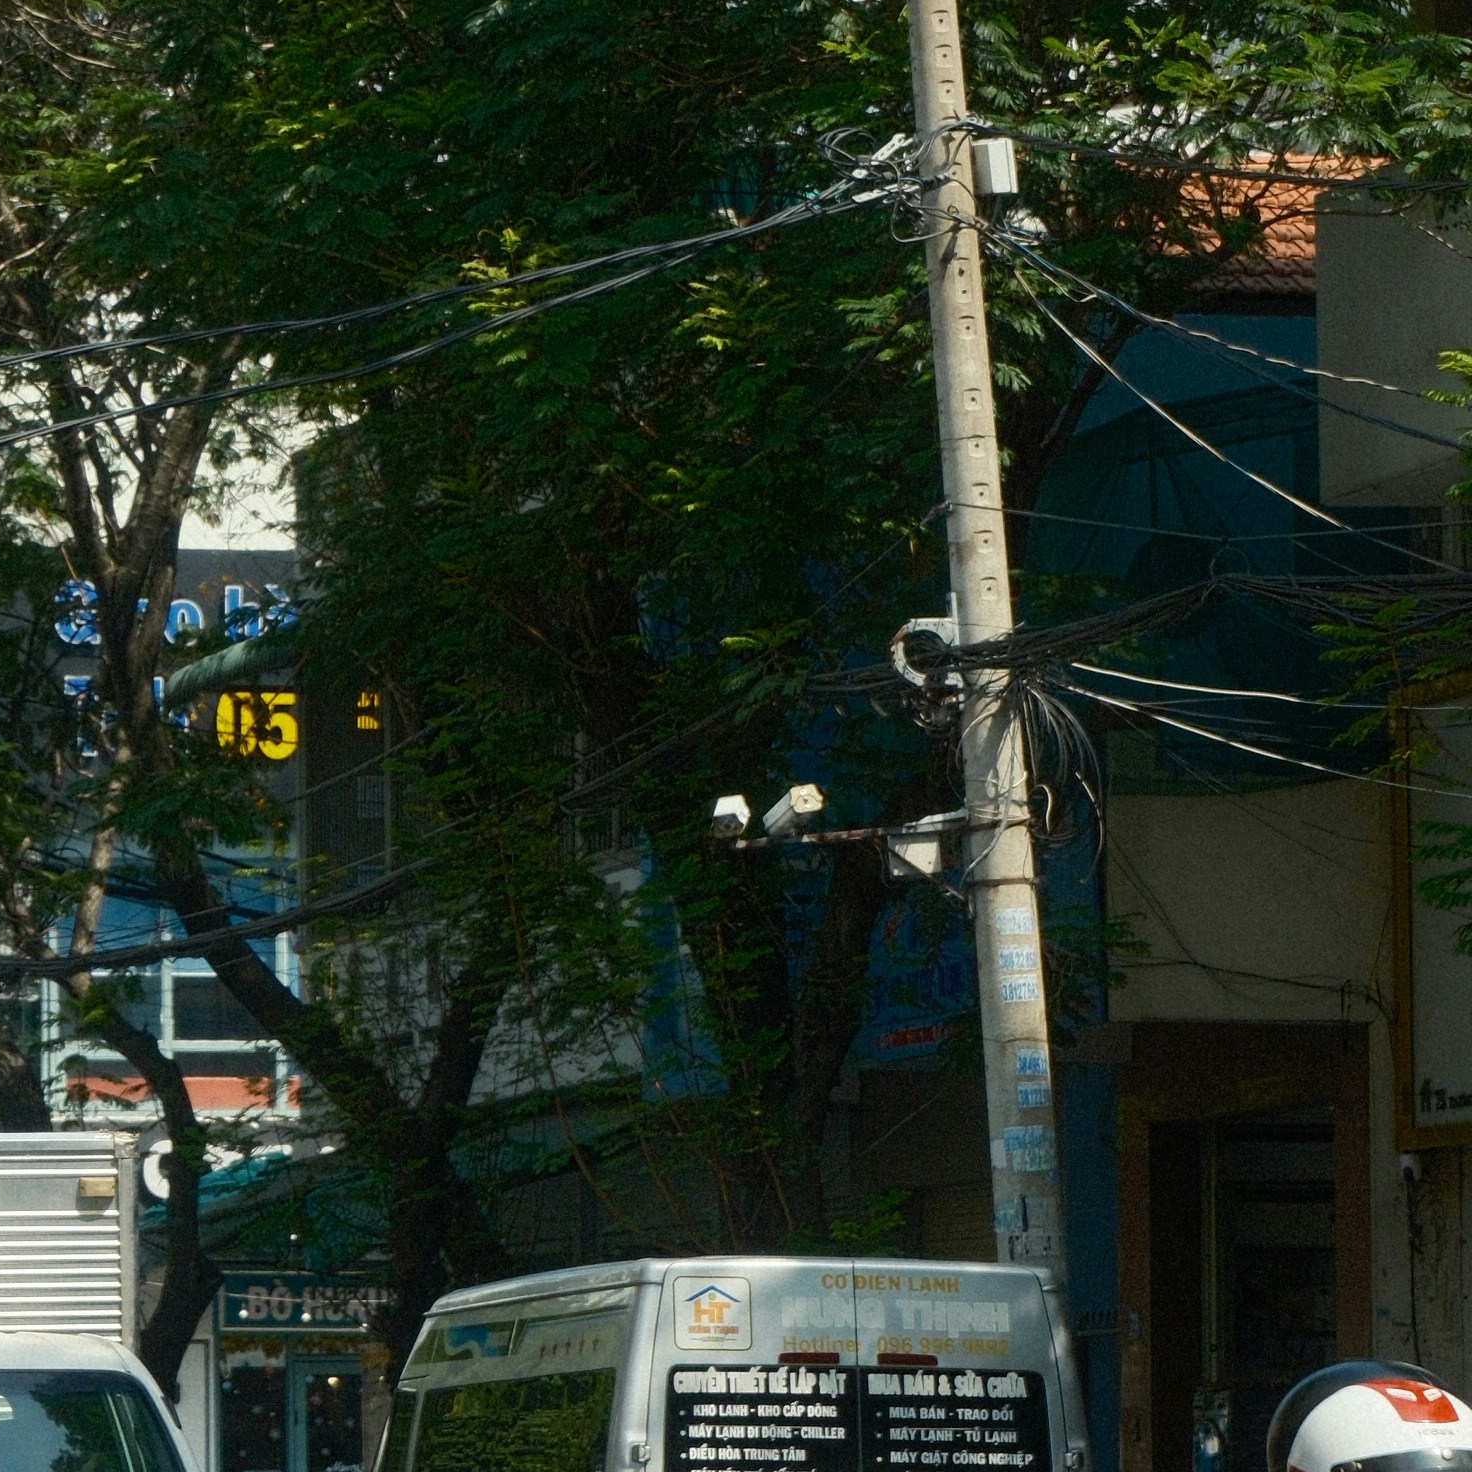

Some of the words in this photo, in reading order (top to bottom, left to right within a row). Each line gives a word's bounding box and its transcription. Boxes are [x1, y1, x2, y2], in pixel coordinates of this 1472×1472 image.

[938, 1374, 952, 1396] &
[693, 1404, 718, 1417] KHO
[758, 1404, 780, 1418] KHO
[889, 1406, 917, 1420] MUA
[920, 1404, 946, 1420] BÁN
[956, 1409, 989, 1421] TRAO
[688, 1423, 712, 1438] MÁY
[715, 1425, 746, 1441] LẠNH
[801, 1427, 846, 1440] CHILLER
[889, 1426, 918, 1441] MÁY
[920, 1428, 954, 1444] LẠNH
[984, 1430, 1017, 1445] LẠNH
[743, 1447, 780, 1461] TRUNG
[782, 1446, 806, 1461] TÂM
[890, 1448, 918, 1463] MÁY
[952, 1449, 986, 1465] CÔNG
